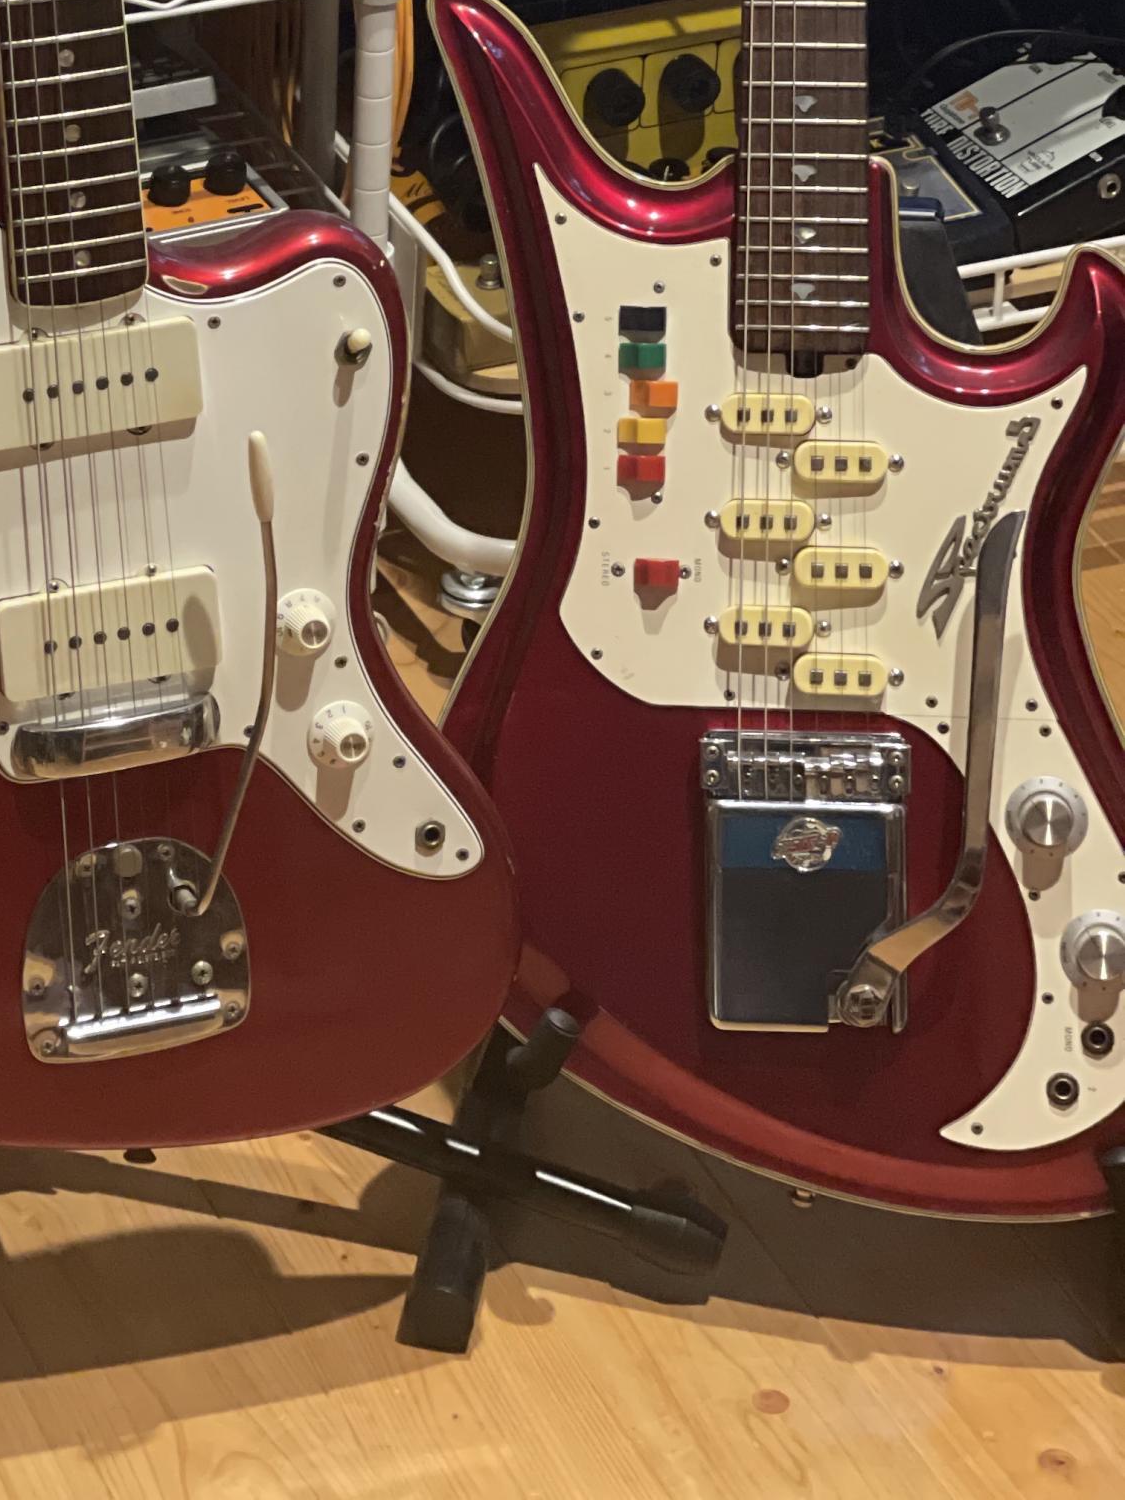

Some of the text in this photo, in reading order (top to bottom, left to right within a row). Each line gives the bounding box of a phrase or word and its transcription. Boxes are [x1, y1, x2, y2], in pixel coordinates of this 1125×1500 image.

[945, 134, 1030, 199] DISTORTION
[601, 550, 611, 587] STEREO
[693, 557, 703, 584] MONO
[83, 921, 181, 974] Fender
[1064, 1026, 1074, 1053] MONO
